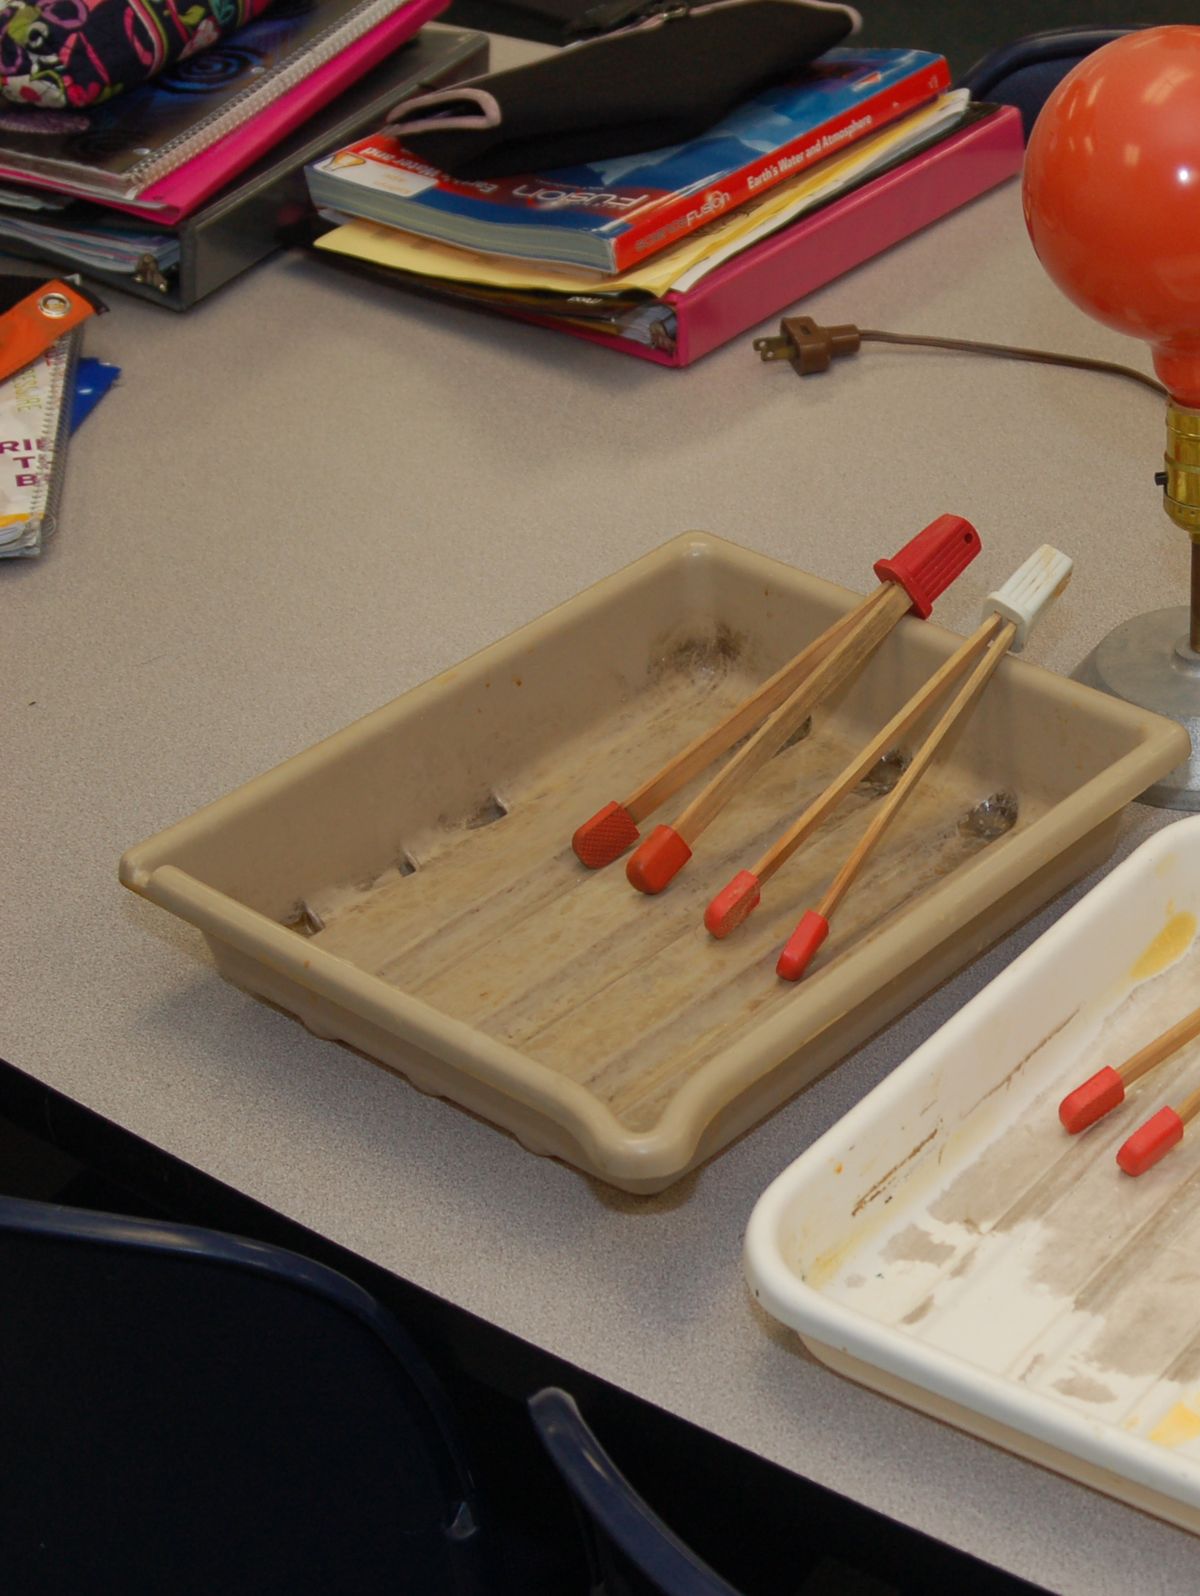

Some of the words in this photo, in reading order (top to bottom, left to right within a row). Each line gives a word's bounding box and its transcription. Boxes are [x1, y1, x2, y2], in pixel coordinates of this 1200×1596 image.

[359, 146, 396, 160] and
[746, 164, 779, 190] Earth's
[777, 151, 805, 173] Water
[805, 138, 822, 158] and
[821, 114, 872, 148] Atmosphere
